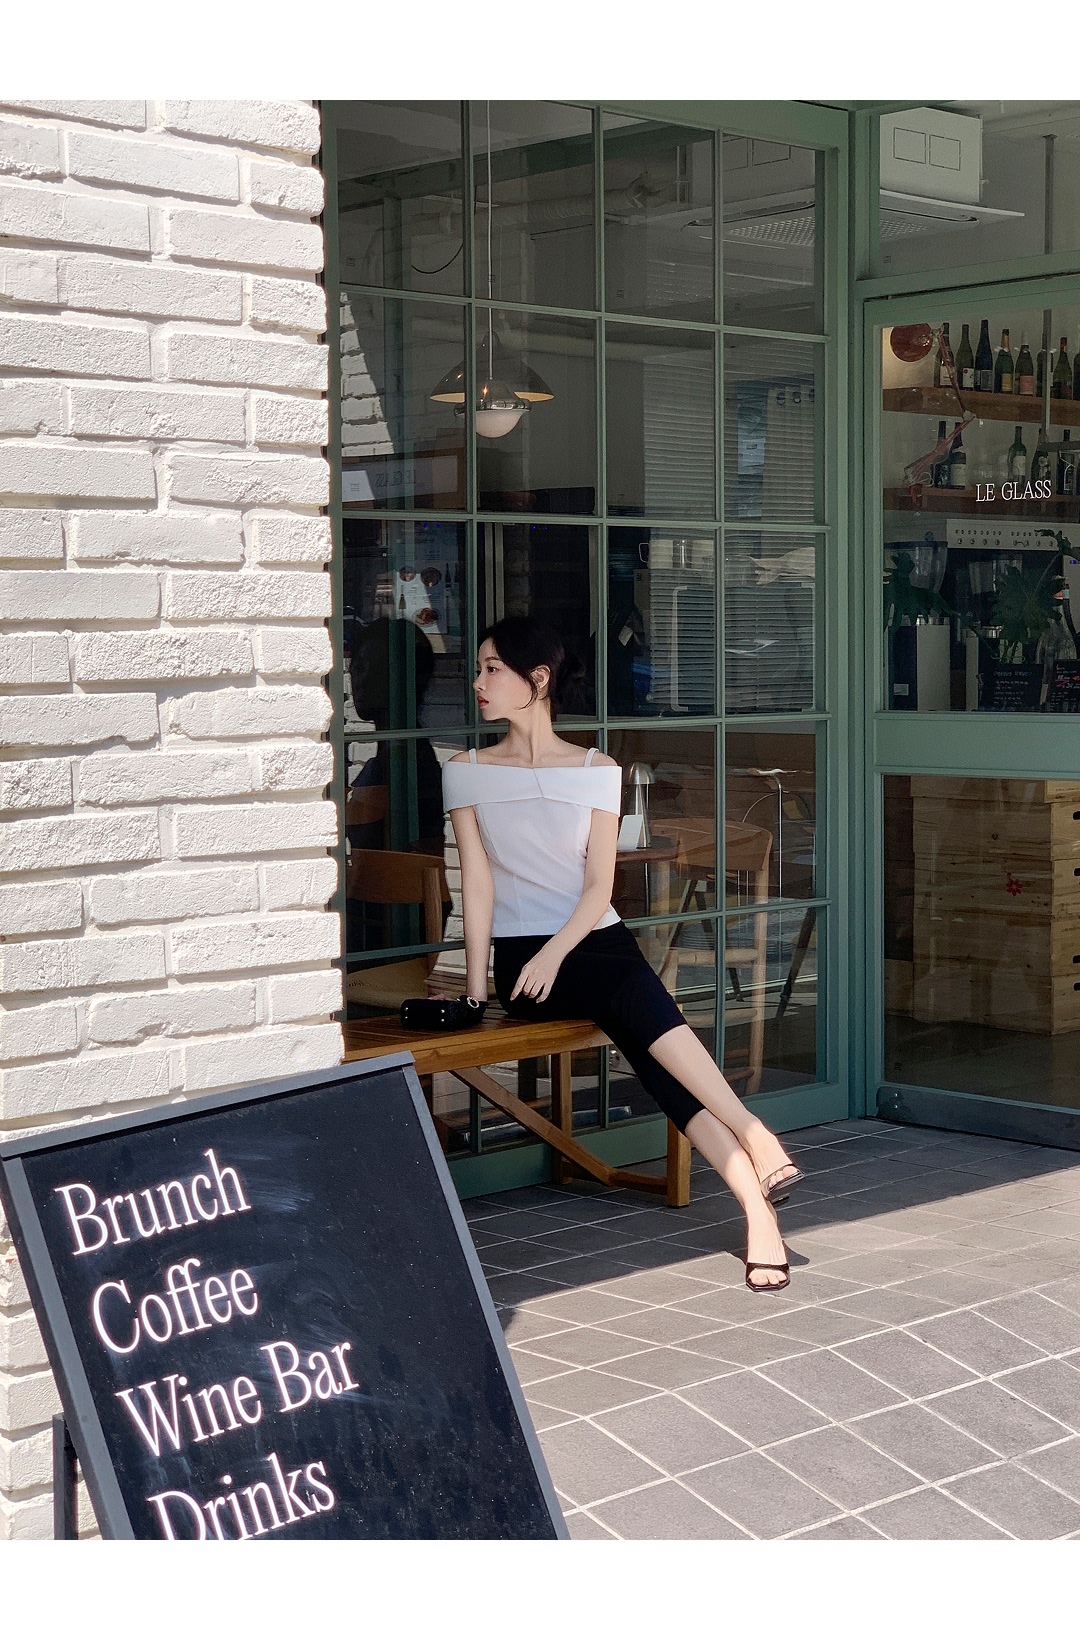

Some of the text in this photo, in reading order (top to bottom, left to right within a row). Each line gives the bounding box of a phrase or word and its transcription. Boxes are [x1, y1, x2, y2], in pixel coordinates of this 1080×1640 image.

[975, 479, 1052, 502] LE GLASS
[54, 1148, 252, 1256] Brunch
[92, 1258, 259, 1354] Coffee
[115, 1340, 360, 1457] Wine Bar
[146, 1452, 335, 1540] Drinks
